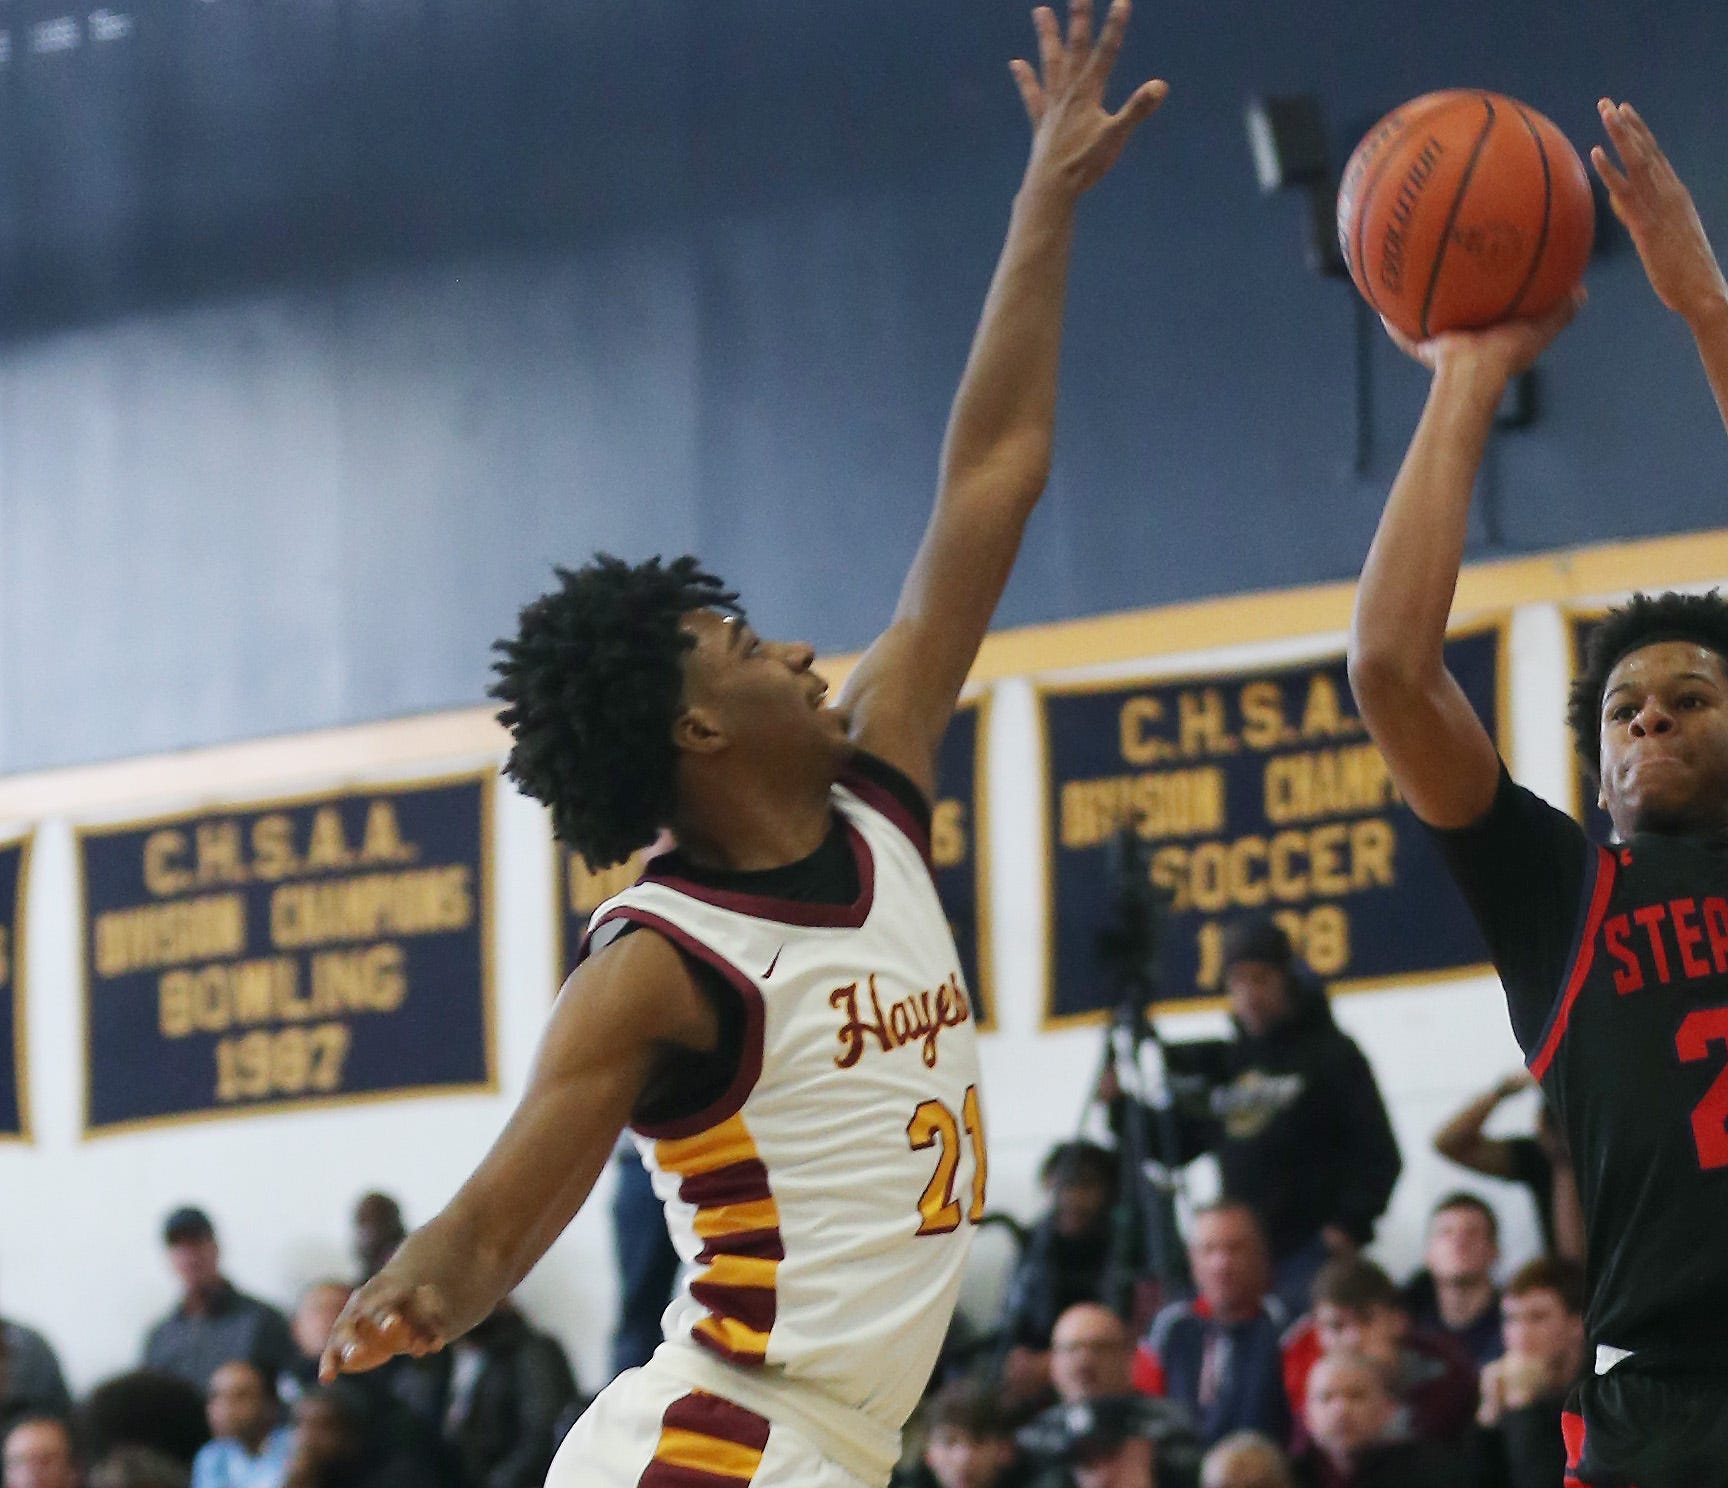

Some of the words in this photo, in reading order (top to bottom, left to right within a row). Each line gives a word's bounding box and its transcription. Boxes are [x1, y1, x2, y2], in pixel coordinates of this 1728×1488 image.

[1149, 818, 1396, 912] SOCCER
[158, 943, 407, 1038] BOWLING
[830, 973, 971, 1069] Hayes
[214, 1022, 352, 1101] 1987
[907, 1084, 987, 1236] 21
